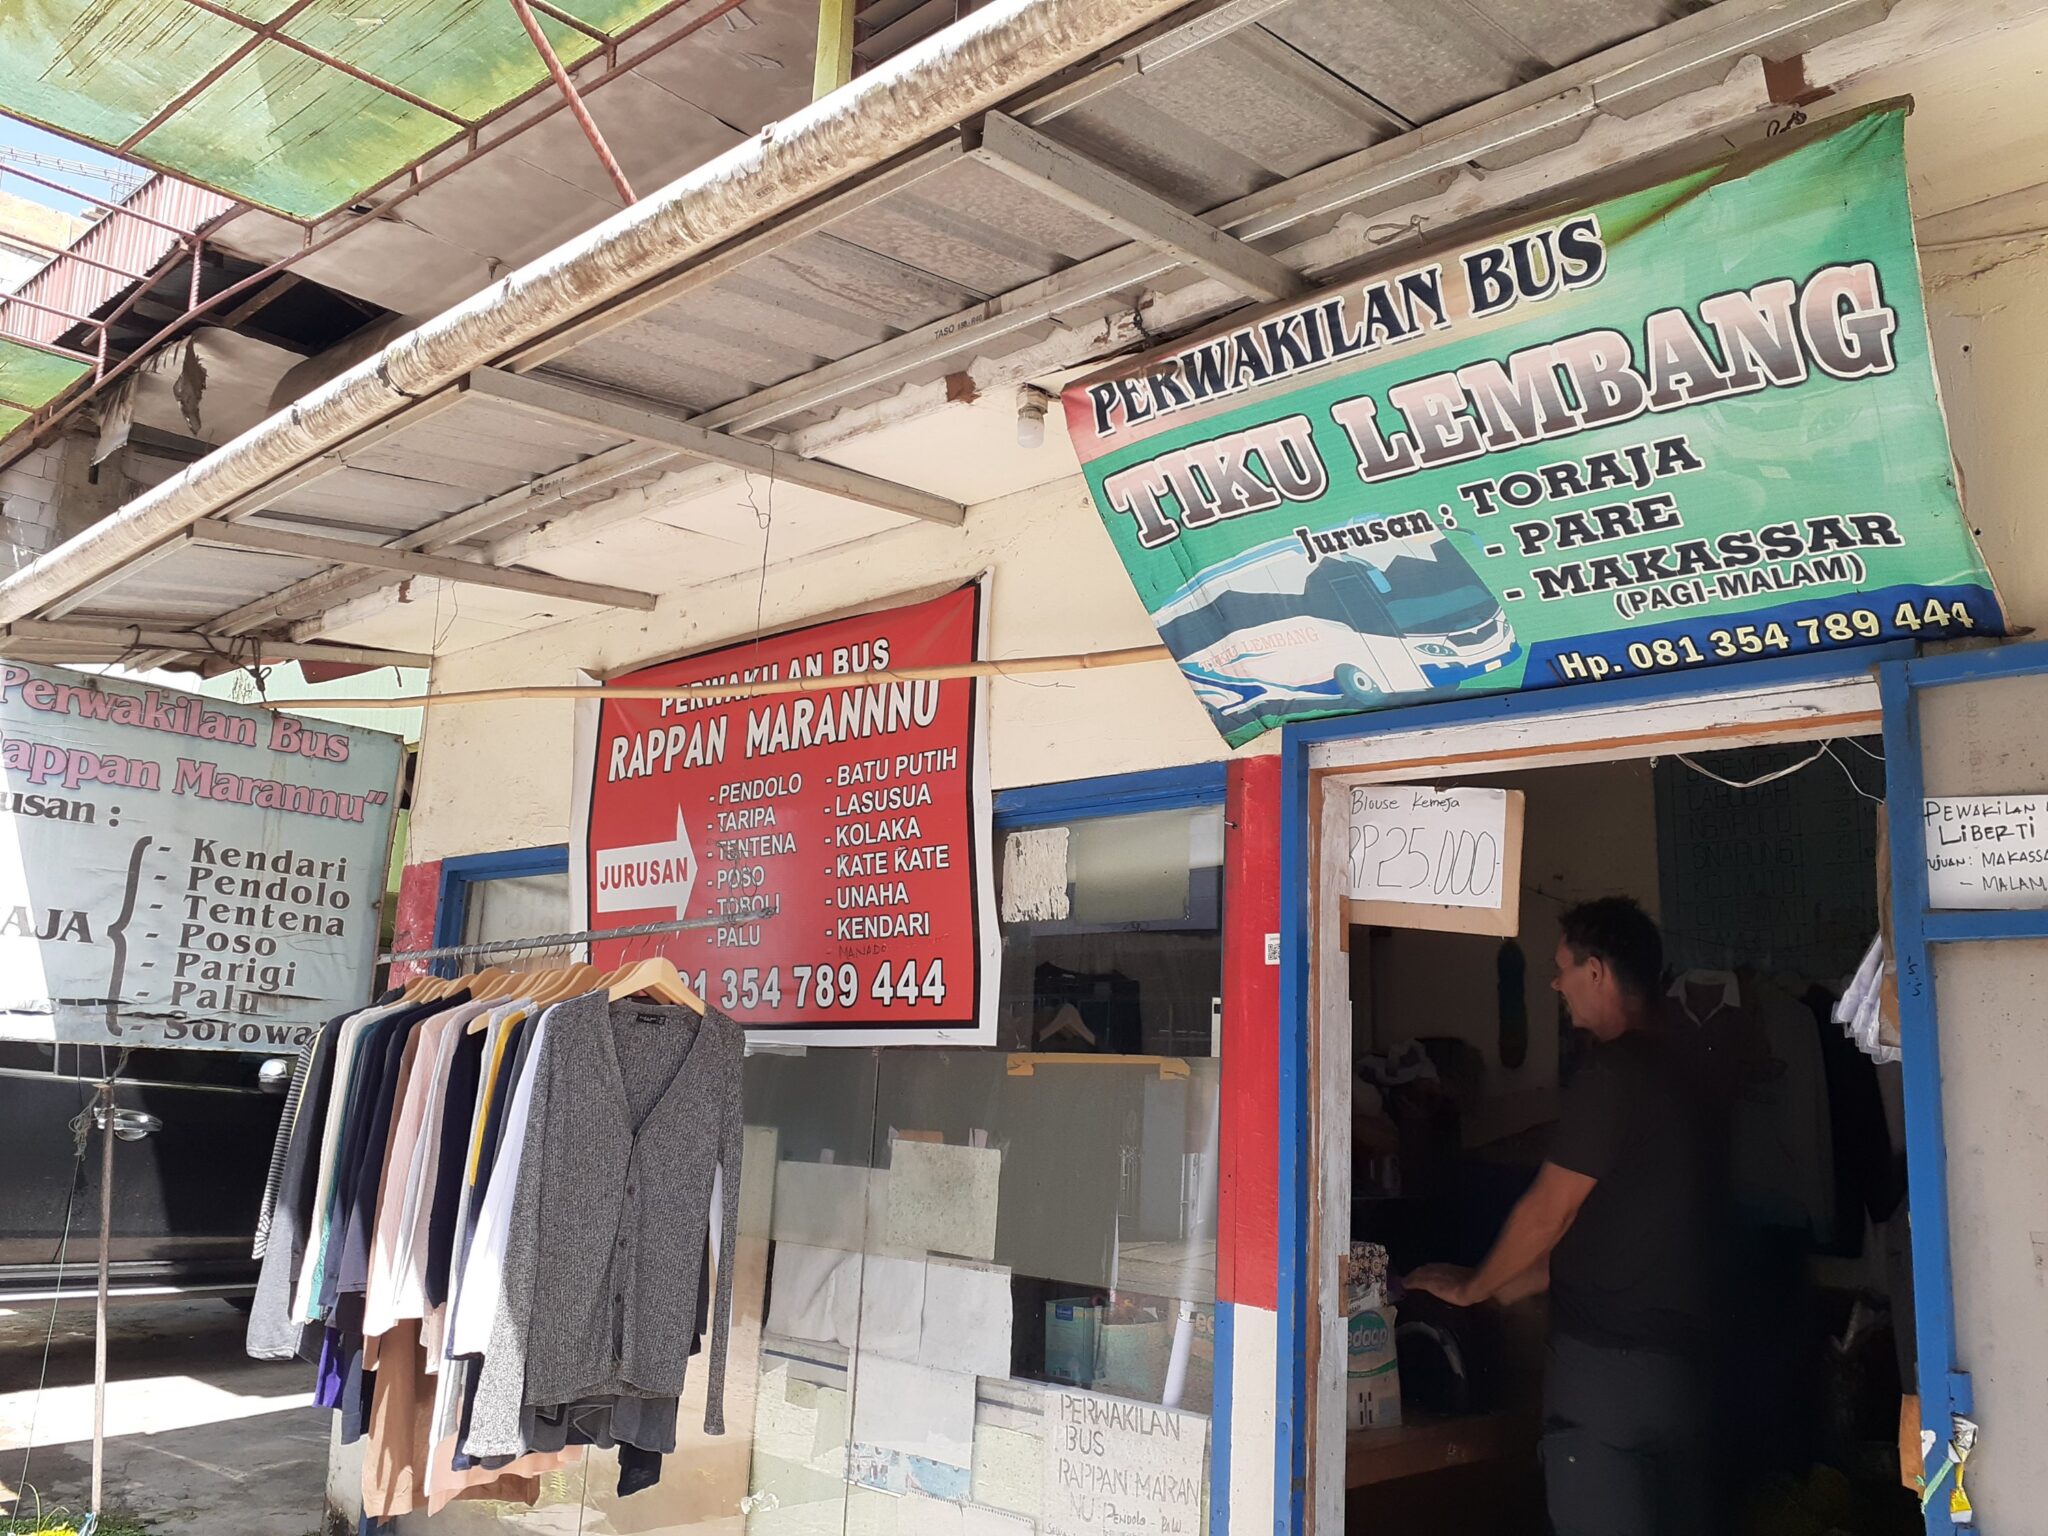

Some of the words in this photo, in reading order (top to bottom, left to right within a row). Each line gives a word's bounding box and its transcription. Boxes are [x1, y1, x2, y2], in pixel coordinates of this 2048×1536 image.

[1086, 264, 1451, 438] PERWAKILAN
[1461, 214, 1606, 320] BUS
[1103, 413, 1329, 549] TIKU
[1331, 262, 1897, 483] LEMBANG
[1459, 434, 1704, 517] TORAJA
[1513, 493, 1683, 558] PARE
[1531, 513, 1904, 602] MAKASSAR
[1615, 552, 1866, 619] (PAGI-MALAM)
[832, 637, 890, 675] BUS
[1555, 651, 1623, 681] Hp.
[1627, 636, 1704, 671] 081
[1708, 620, 1790, 660] 354
[1796, 607, 1880, 646] 789
[1893, 597, 1975, 633] 444
[0, 663, 257, 747] Perwakilan
[267, 715, 350, 763] Bus
[607, 715, 728, 783] RAPPAN
[745, 680, 940, 759] MARANNNU
[0, 728, 161, 791] appan
[837, 758, 889, 787] BATU
[894, 747, 958, 778] PUTIH
[718, 773, 802, 805] PENDOLO
[835, 783, 932, 817] LASUSUA
[1352, 790, 1399, 815] Blouse
[717, 805, 776, 832] TARIPA
[836, 816, 922, 848] KOLAKA
[191, 837, 348, 883] Kendari
[717, 832, 797, 861] TENTENA
[836, 851, 888, 878] KATE
[894, 845, 950, 873] KATE
[187, 865, 351, 910] Pendolo
[599, 857, 689, 892] JURUSAN
[717, 865, 765, 890] POSO
[1982, 875, 2048, 892] MALAM
[837, 881, 910, 909] UNAHA
[183, 894, 345, 937] Tentena
[837, 911, 930, 940] KENDARI
[179, 924, 277, 956] Poso
[717, 925, 760, 947] PALU
[174, 952, 297, 992] Parigi
[721, 966, 782, 1009] 354
[793, 962, 859, 1008] 789
[871, 958, 946, 1007] 444
[169, 981, 259, 1015] Palu
[164, 1010, 327, 1045] Sorowa
[1060, 1393, 1180, 1441] PERWAKILAN
[1065, 1425, 1105, 1456] BUS
[1059, 1458, 1128, 1495] RAPPAN
